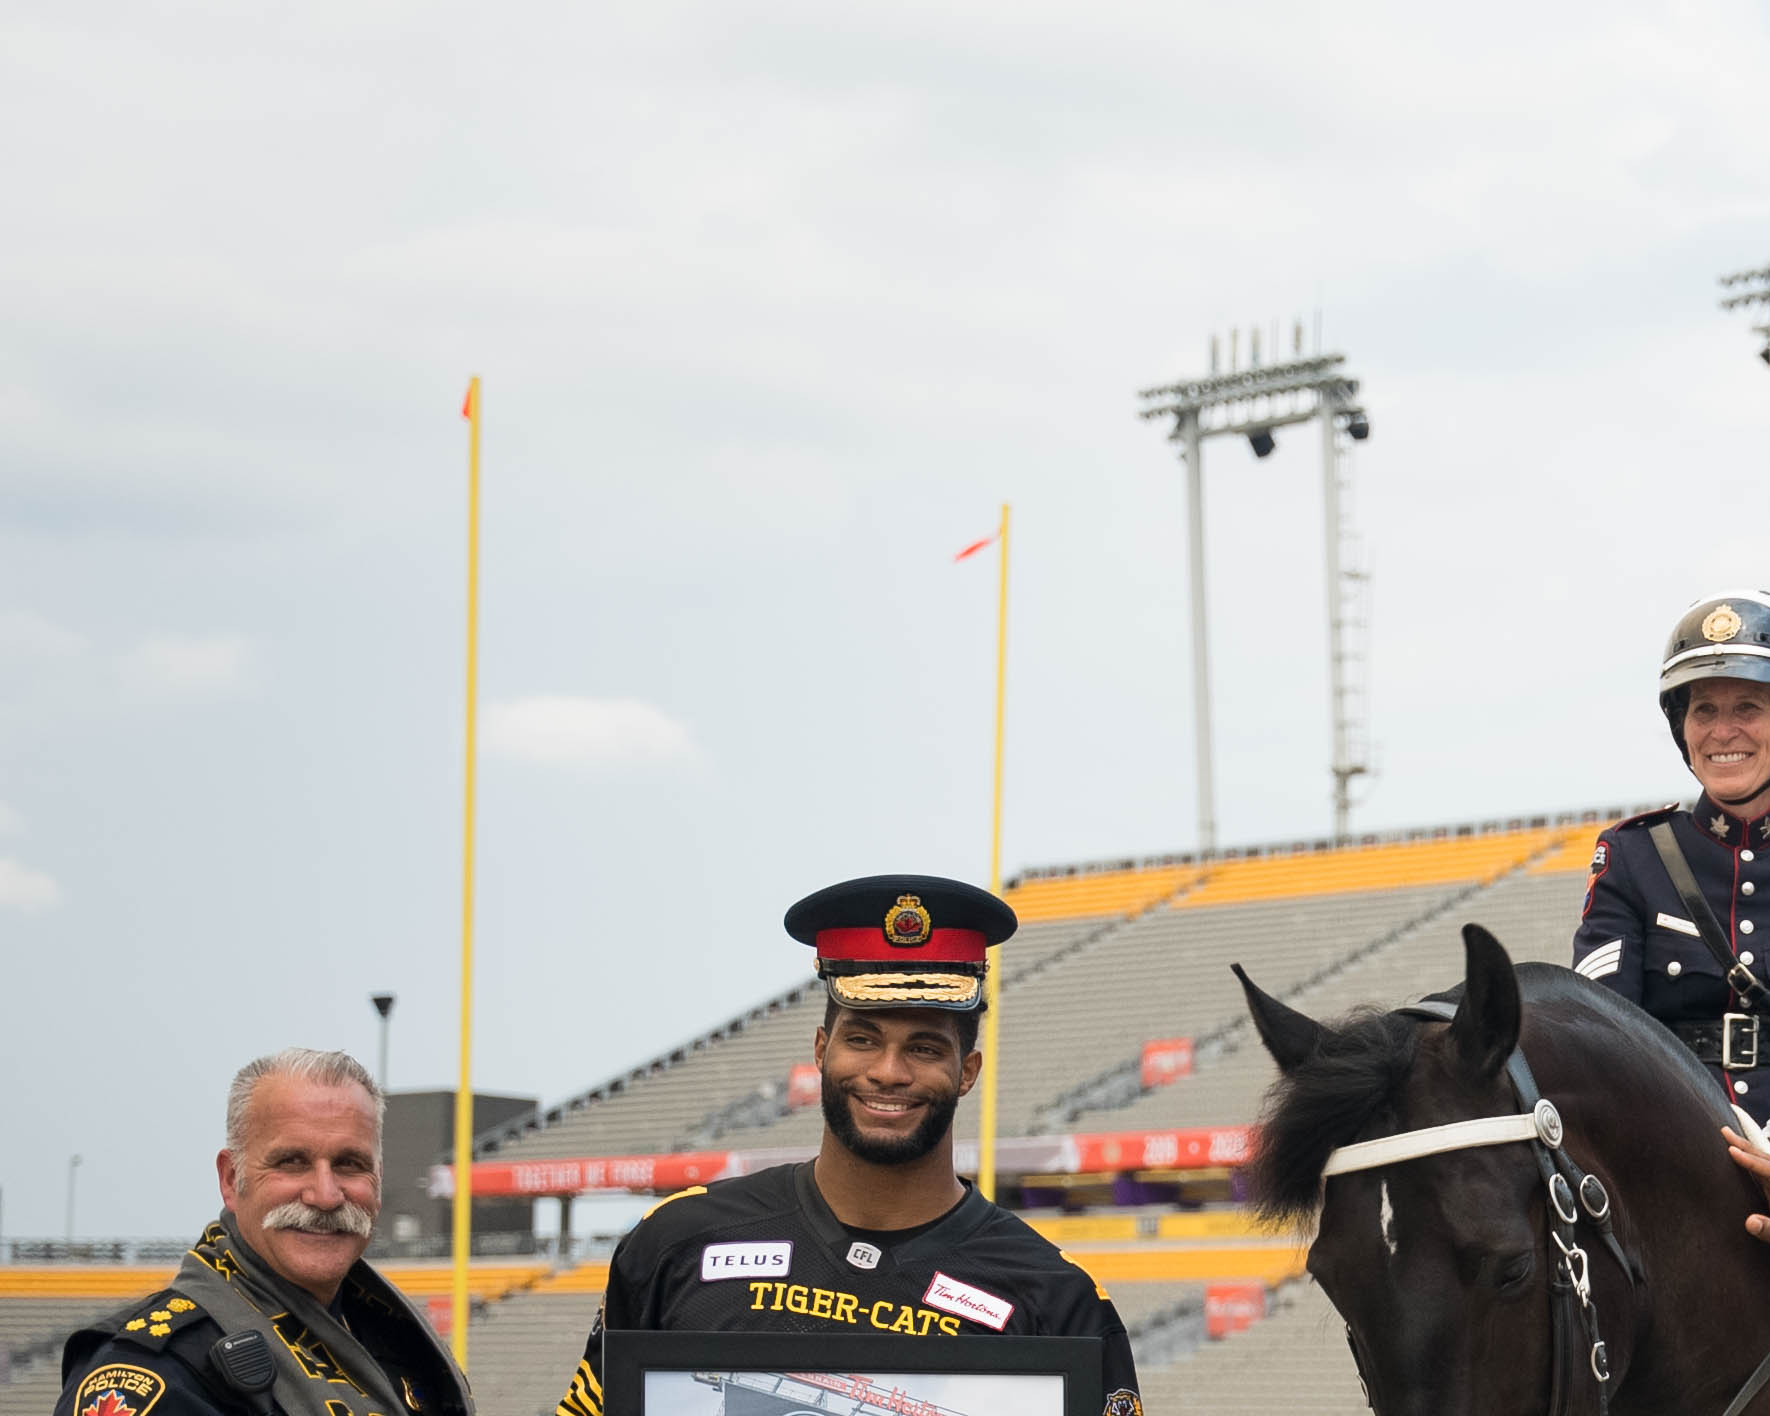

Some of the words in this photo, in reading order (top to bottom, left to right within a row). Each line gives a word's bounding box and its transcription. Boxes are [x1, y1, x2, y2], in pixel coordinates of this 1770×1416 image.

[710, 1253, 784, 1268] TELUS
[852, 1248, 874, 1264] CFL
[933, 1283, 954, 1302] Tim
[749, 1281, 962, 1337] TIGER-CATS
[90, 1370, 155, 1386] HAMILTON
[84, 1378, 153, 1398] POLICE
